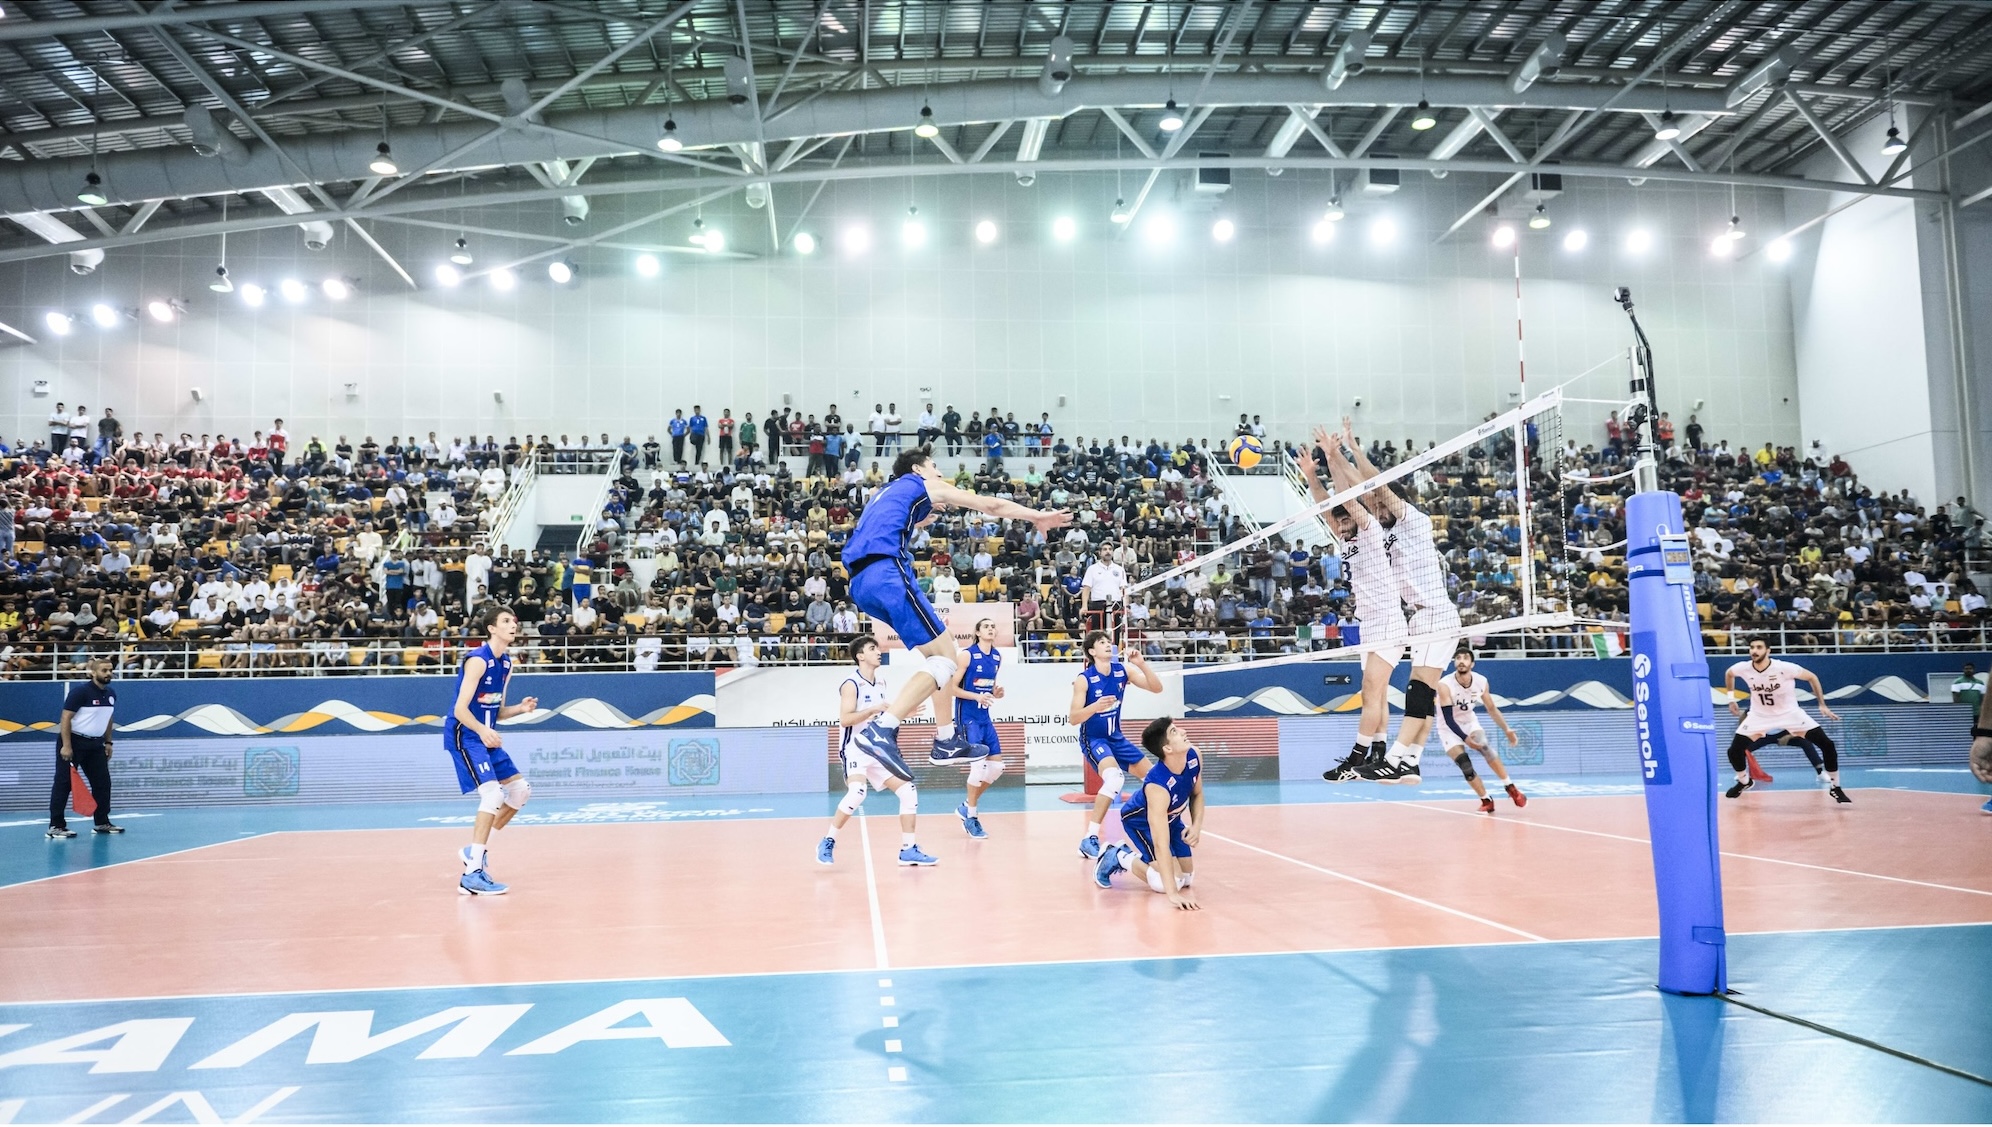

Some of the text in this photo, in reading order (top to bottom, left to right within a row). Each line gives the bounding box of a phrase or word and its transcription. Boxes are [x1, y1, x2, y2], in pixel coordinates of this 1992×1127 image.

[1758, 693, 1775, 706] 15
[1636, 682, 1658, 778] Senoh
[1034, 736, 1079, 744] WELCOMIN
[478, 762, 490, 773] 14
[849, 761, 858, 769] 13
[0, 999, 731, 1075] AMA
